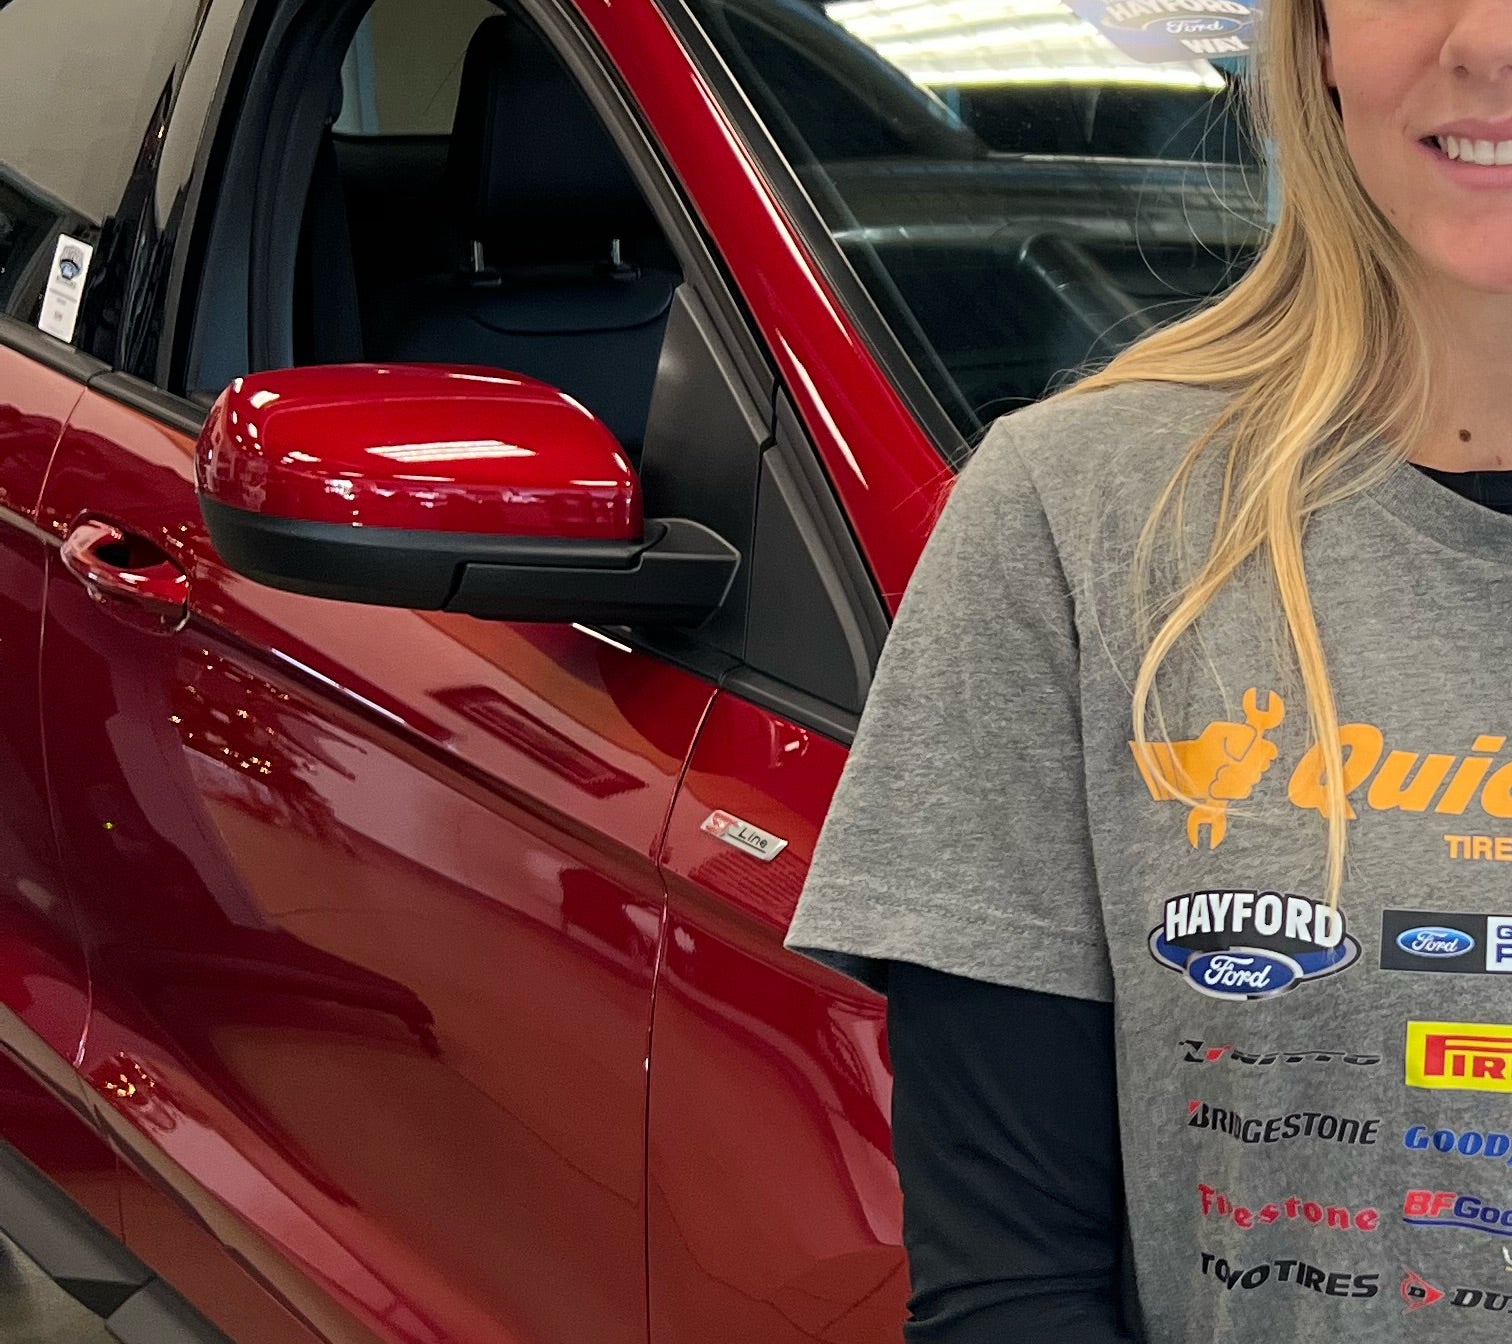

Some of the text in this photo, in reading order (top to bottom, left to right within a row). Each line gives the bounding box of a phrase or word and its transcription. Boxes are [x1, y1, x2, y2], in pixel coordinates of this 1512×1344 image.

[1166, 20, 1224, 34] Ford
[1180, 35, 1250, 54] WAY
[737, 827, 769, 849] Line
[1165, 892, 1344, 949] HAYFORD
[1410, 929, 1460, 954] Ford
[1203, 954, 1273, 989] Ford
[1187, 1098, 1381, 1145] BRIDGESTONE
[1200, 1252, 1381, 1298] TOYO TIRES
